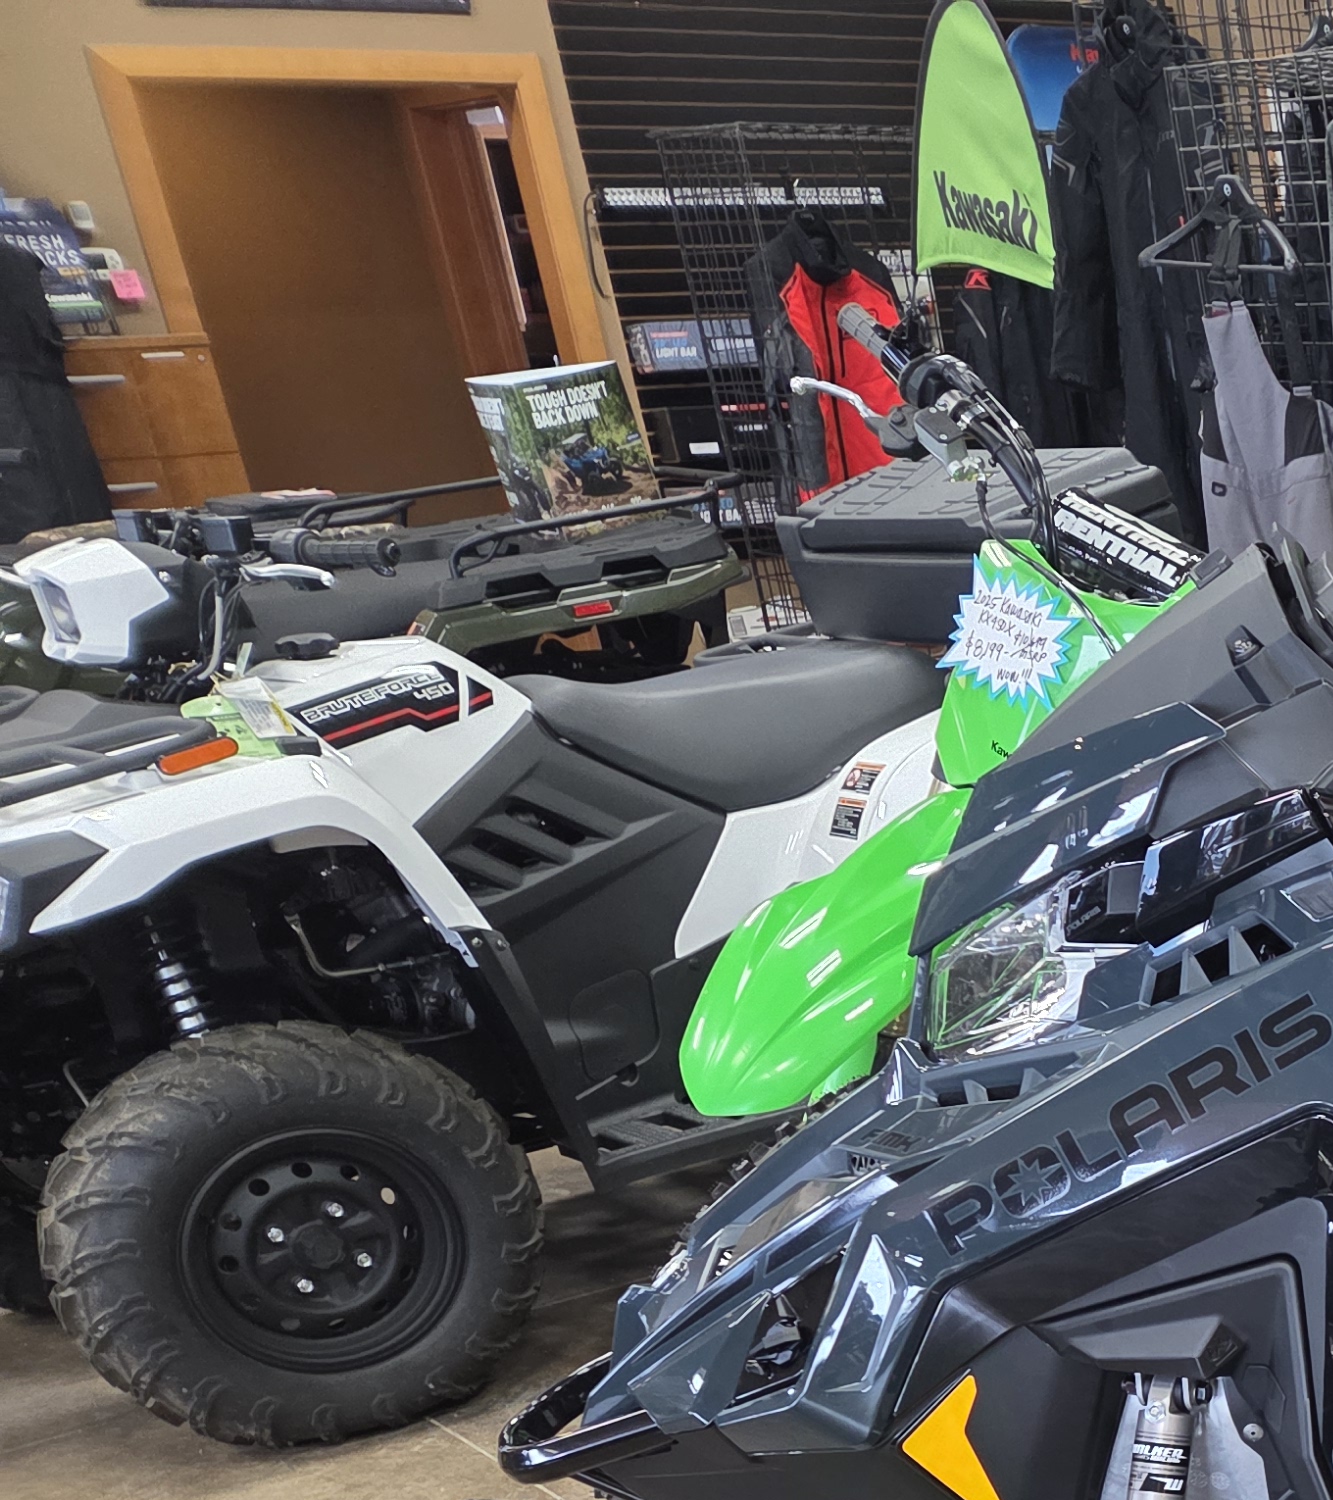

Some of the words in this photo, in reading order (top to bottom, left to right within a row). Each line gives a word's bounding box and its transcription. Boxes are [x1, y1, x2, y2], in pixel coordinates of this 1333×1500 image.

[933, 170, 1039, 254] Kawasaki
[655, 347, 678, 359] LIGHT
[679, 345, 697, 358] BAR
[525, 391, 569, 412] TOUGH
[531, 408, 566, 430] BACK
[565, 401, 599, 422] DOWN
[1053, 508, 1182, 589] RENTHAL
[974, 590, 1003, 610] 2025
[413, 682, 455, 701] 450
[922, 992, 1333, 1258] POLARIS
